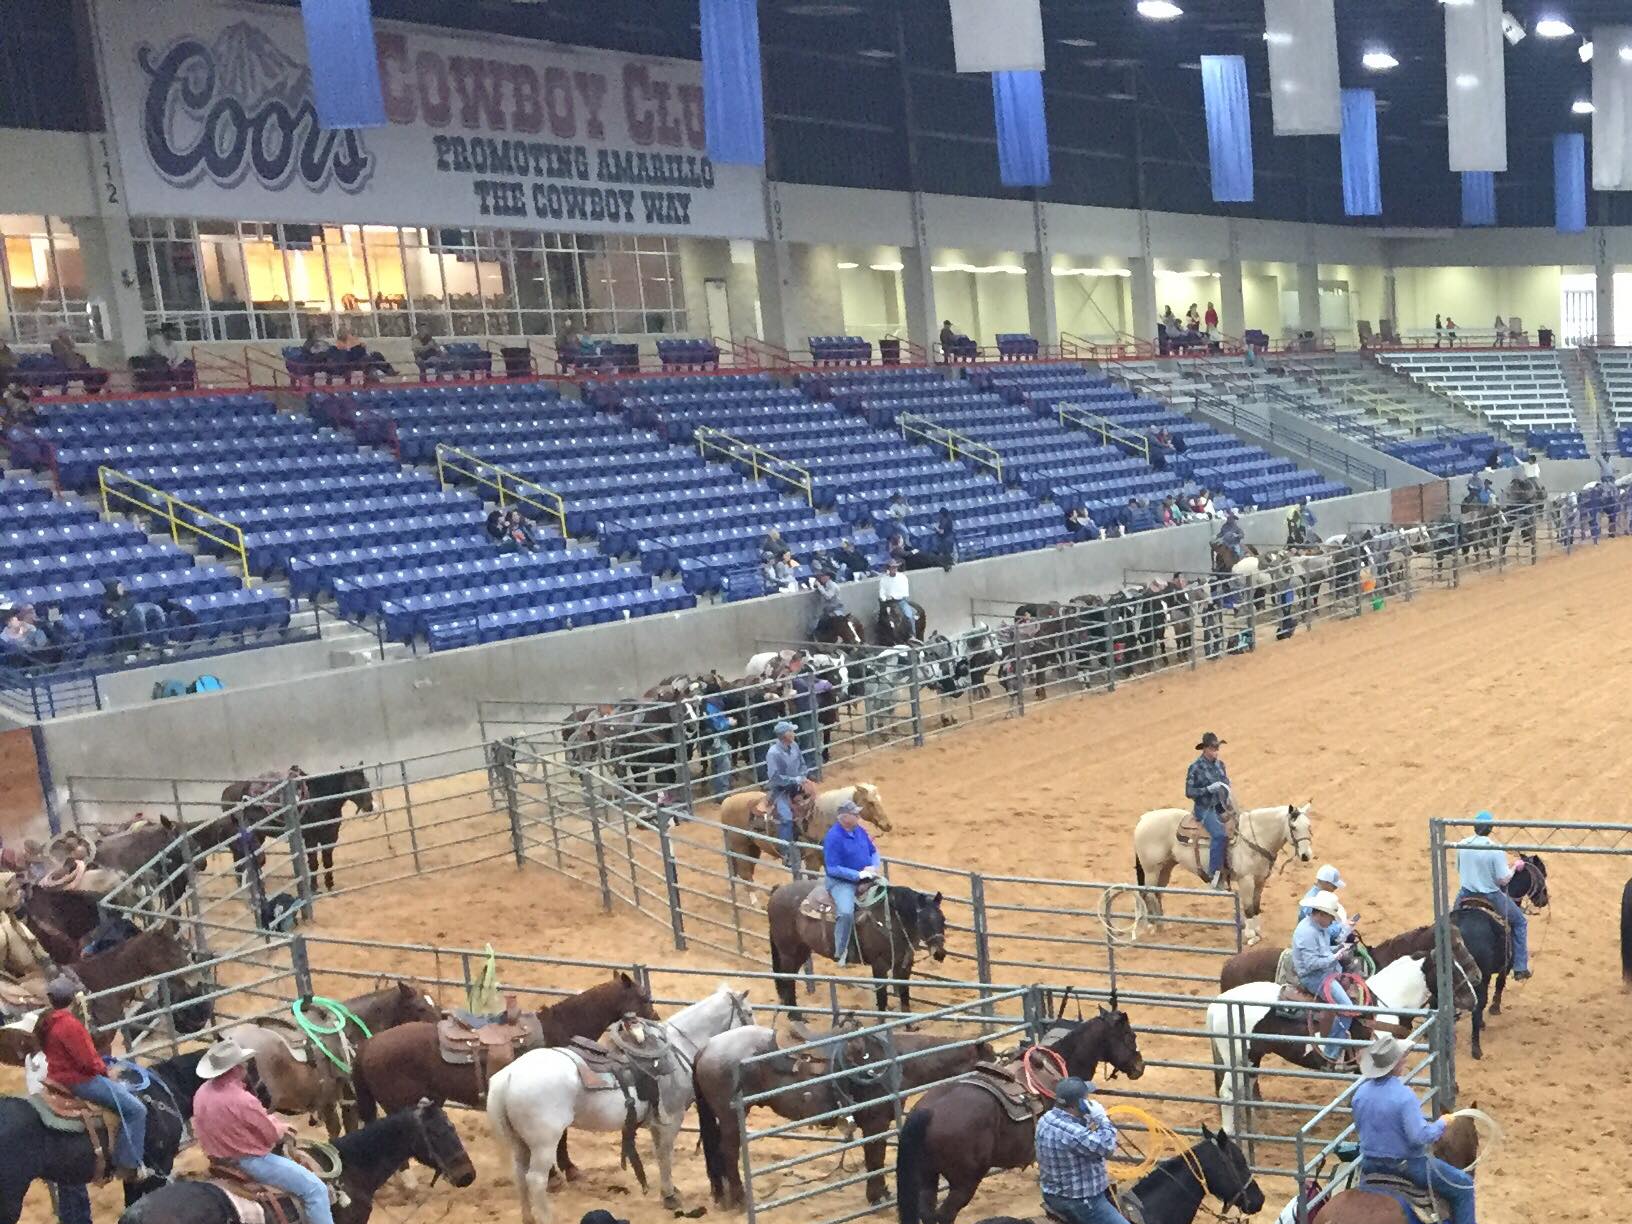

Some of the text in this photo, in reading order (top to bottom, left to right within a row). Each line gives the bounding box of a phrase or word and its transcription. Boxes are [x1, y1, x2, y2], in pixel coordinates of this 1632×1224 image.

[136, 38, 371, 189] Coors
[622, 62, 707, 150] CLU
[100, 138, 120, 205] 112
[432, 134, 716, 190] PROMOTING AMARILLO
[473, 180, 692, 225] THE COWBOY WAY
